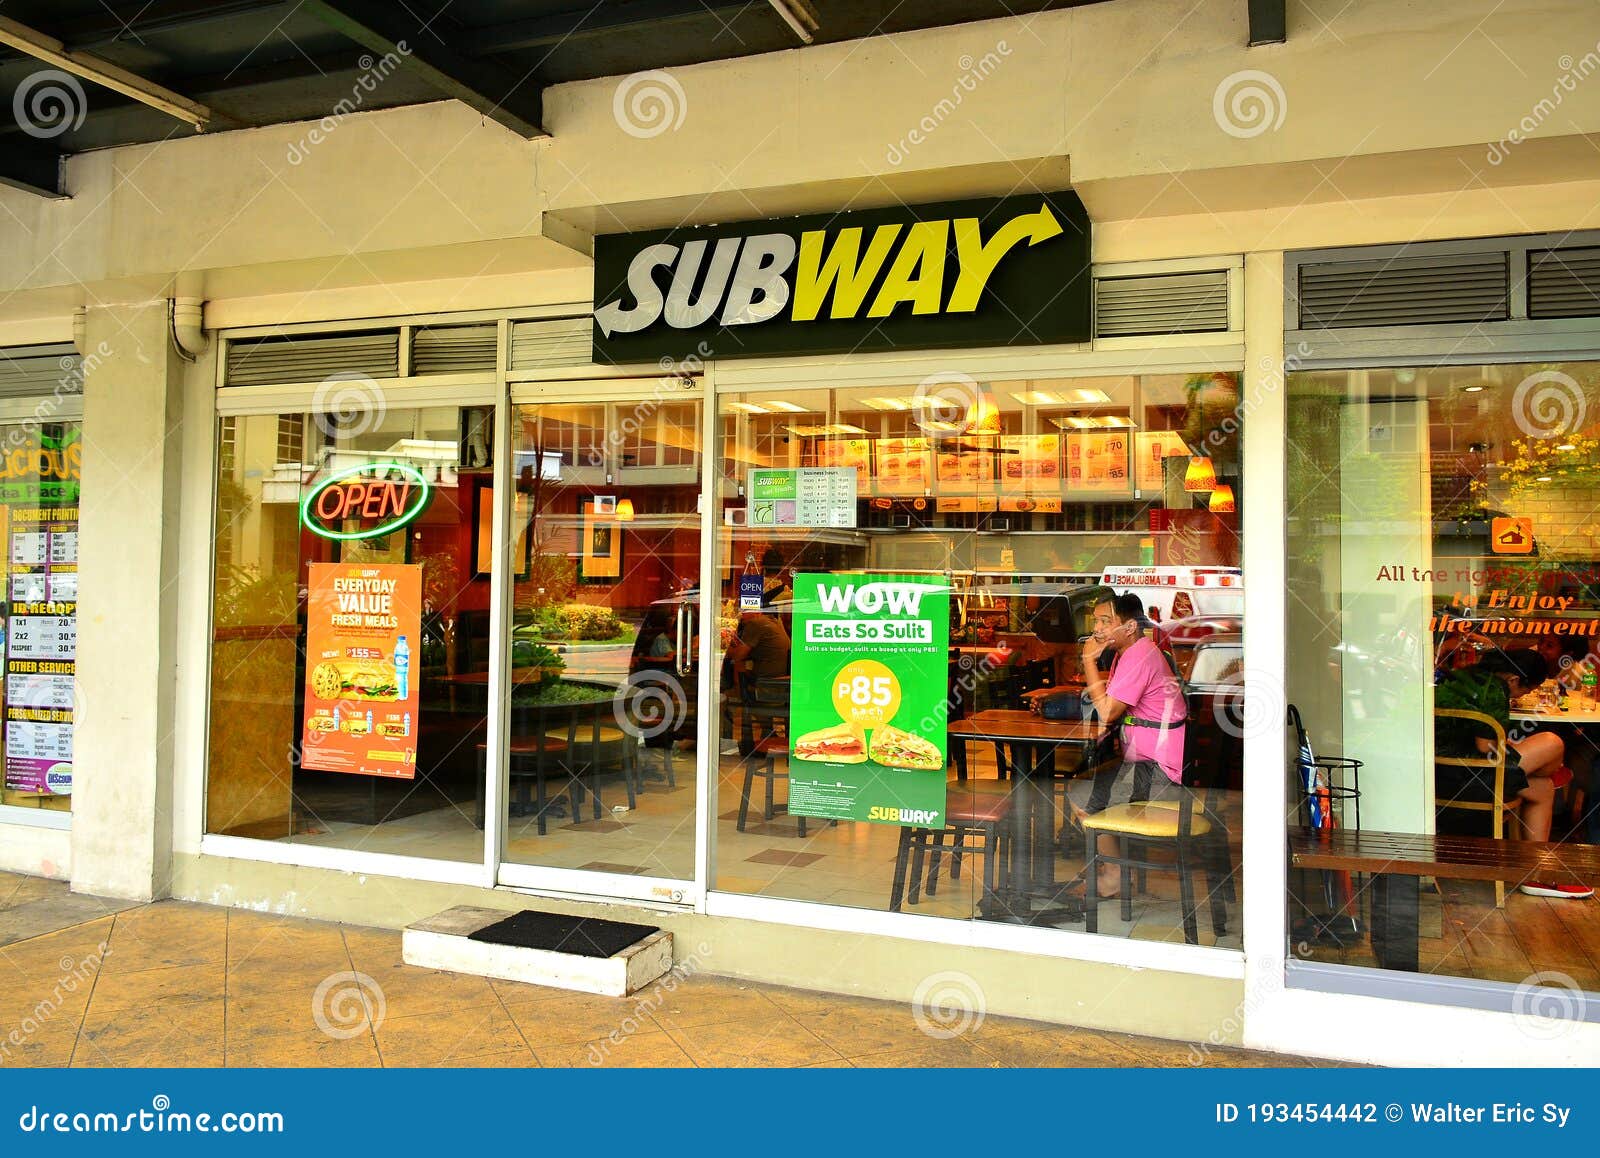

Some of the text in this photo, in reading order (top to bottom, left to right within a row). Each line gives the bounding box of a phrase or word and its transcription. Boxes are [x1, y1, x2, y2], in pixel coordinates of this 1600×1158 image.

[594, 202, 1063, 340] SUBWAY
[0, 440, 80, 480] icious
[757, 477, 790, 486] SUBWAY
[27, 485, 66, 498] Place
[317, 480, 409, 521] OPEN
[13, 508, 52, 521] DOCUMENT
[1376, 565, 1405, 582] All
[1455, 565, 1512, 587] right
[334, 578, 397, 593] EVERYDAY
[741, 583, 762, 592] OPEN
[338, 593, 392, 614] VALUE
[816, 582, 925, 618] WOW
[1488, 589, 1574, 615] Enjoy
[30, 602, 77, 614] RECOP
[16, 618, 27, 626] 1x1
[331, 614, 398, 627] FRESH MEALS
[1428, 614, 1599, 636] the moment
[15, 632, 28, 640] 2x2
[812, 623, 926, 639] Eats So Sulit
[9, 661, 37, 673] OTHER
[8, 708, 51, 720] PERSONALIZED
[868, 807, 939, 825] SUBWAY
